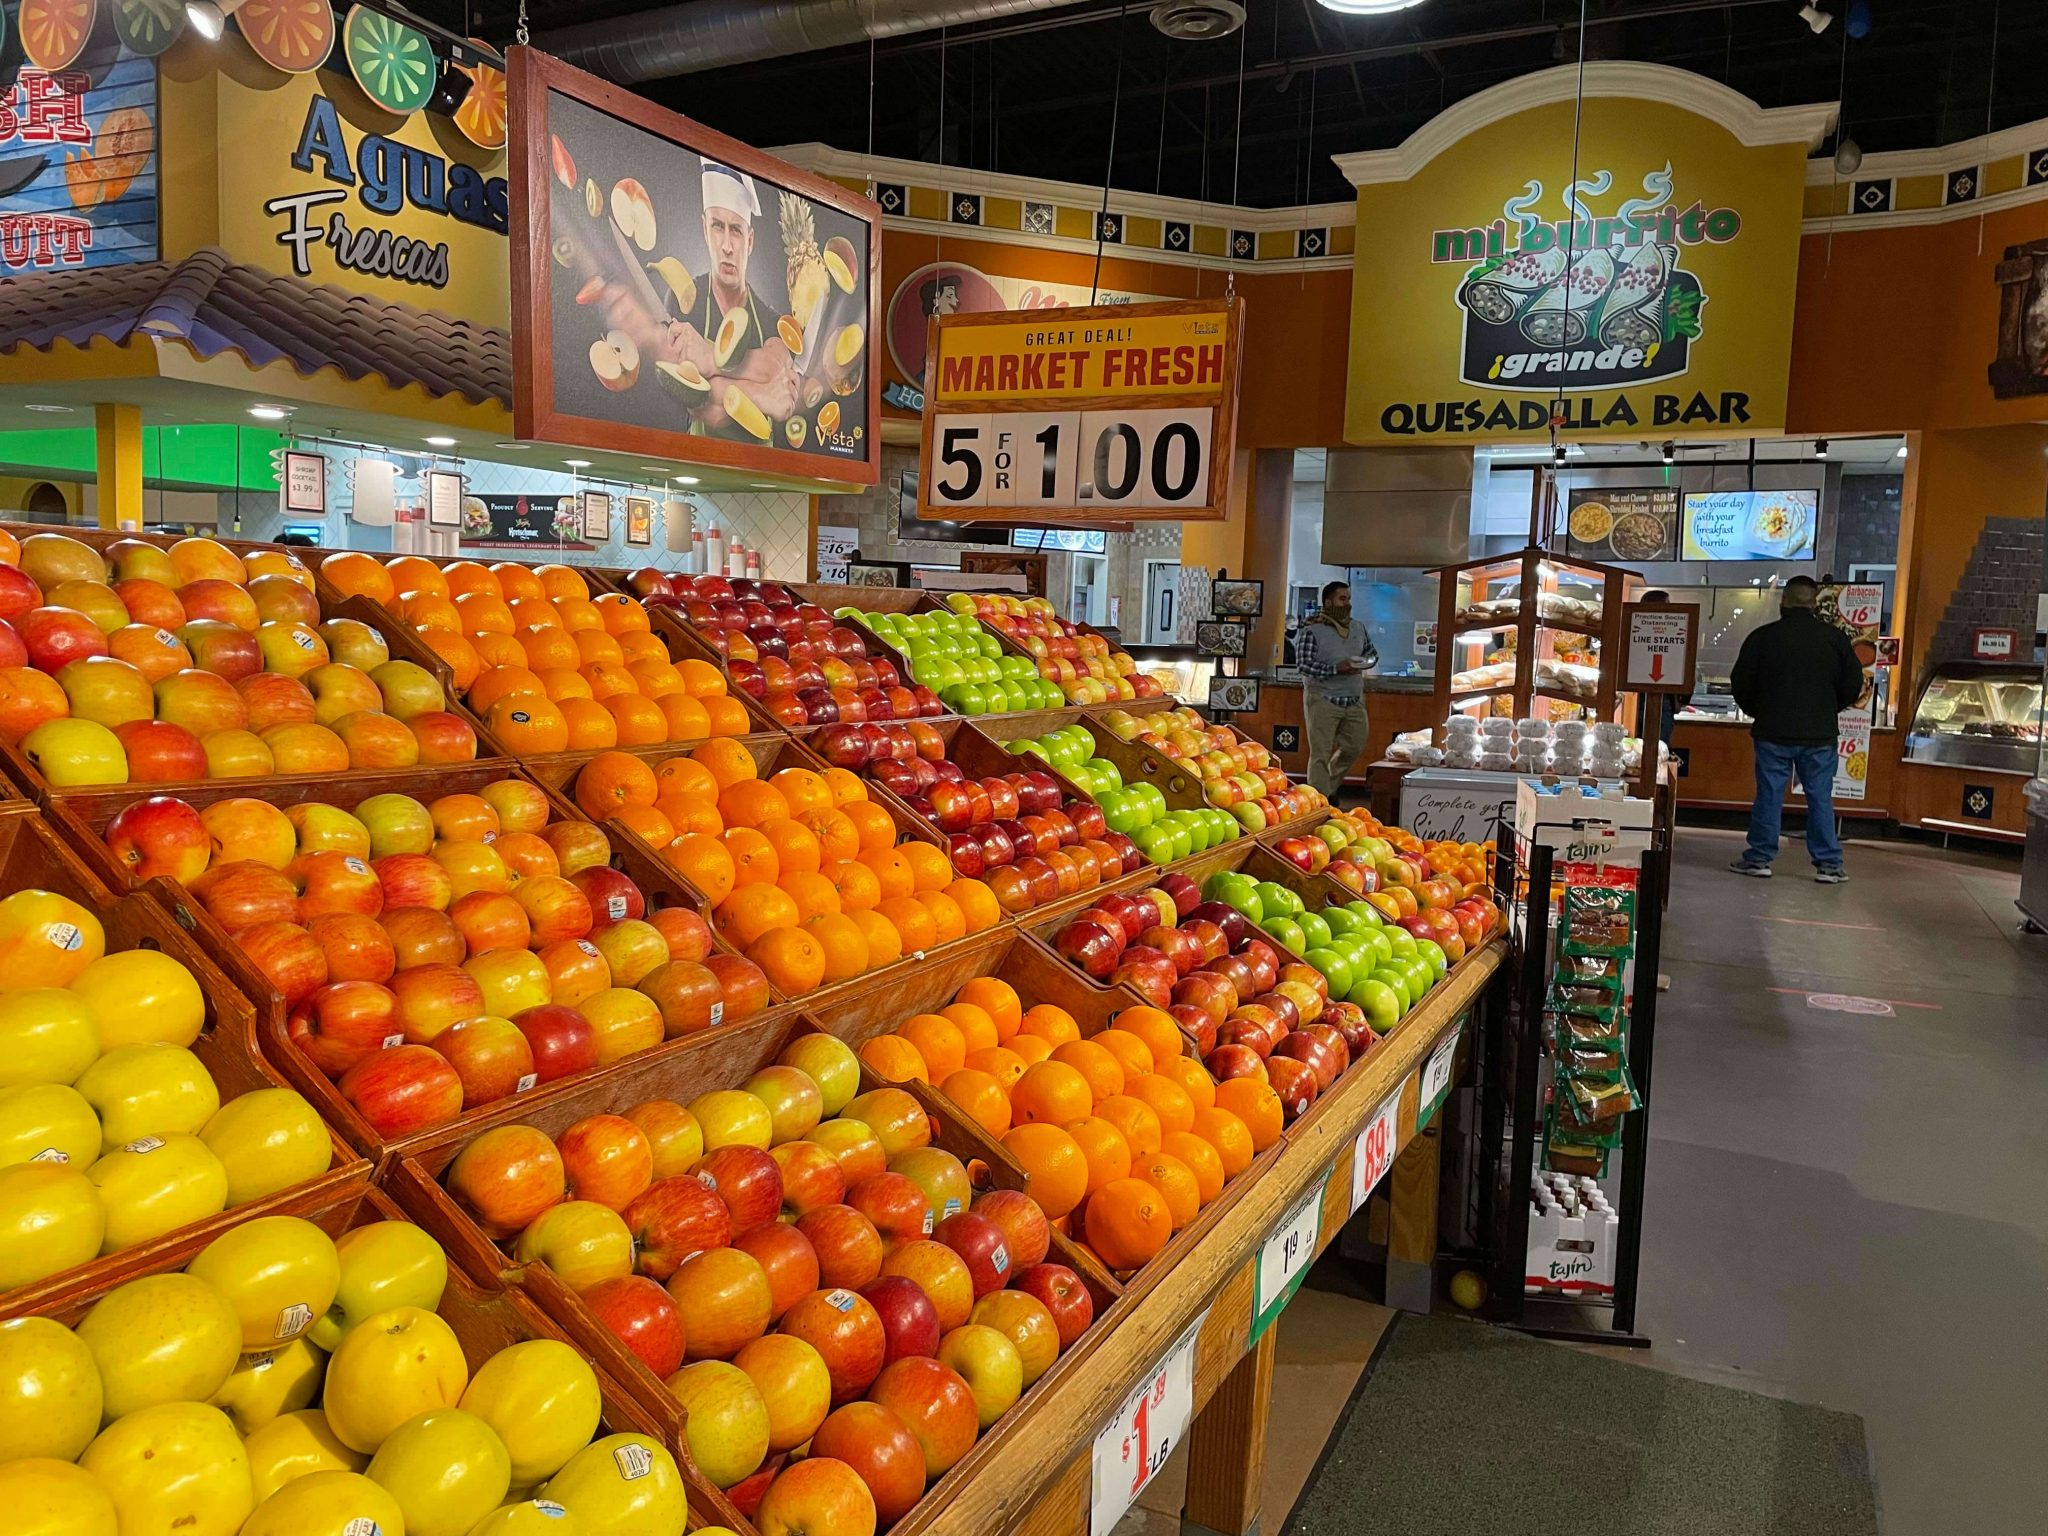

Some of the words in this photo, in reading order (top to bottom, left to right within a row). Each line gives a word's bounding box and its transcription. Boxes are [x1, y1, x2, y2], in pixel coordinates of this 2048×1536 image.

[291, 93, 509, 236] Aguas
[263, 189, 449, 288] Frescas
[1432, 219, 1506, 262] mi
[1518, 200, 1742, 255] burrito
[1026, 331, 1075, 346] GREAT
[1084, 327, 1132, 344] DEAL!
[941, 351, 1090, 393] MARKET
[1103, 344, 1223, 387] FRESH
[1653, 392, 1750, 426] BAR
[937, 428, 982, 501] 5
[1688, 500, 1707, 508] Start
[1709, 501, 1728, 511] your
[1730, 497, 1745, 510] day
[1697, 512, 1714, 520] with
[1716, 514, 1735, 524] your
[1697, 523, 1734, 537] breakfast
[1700, 537, 1729, 546] burrito
[1418, 794, 1476, 812] Complete
